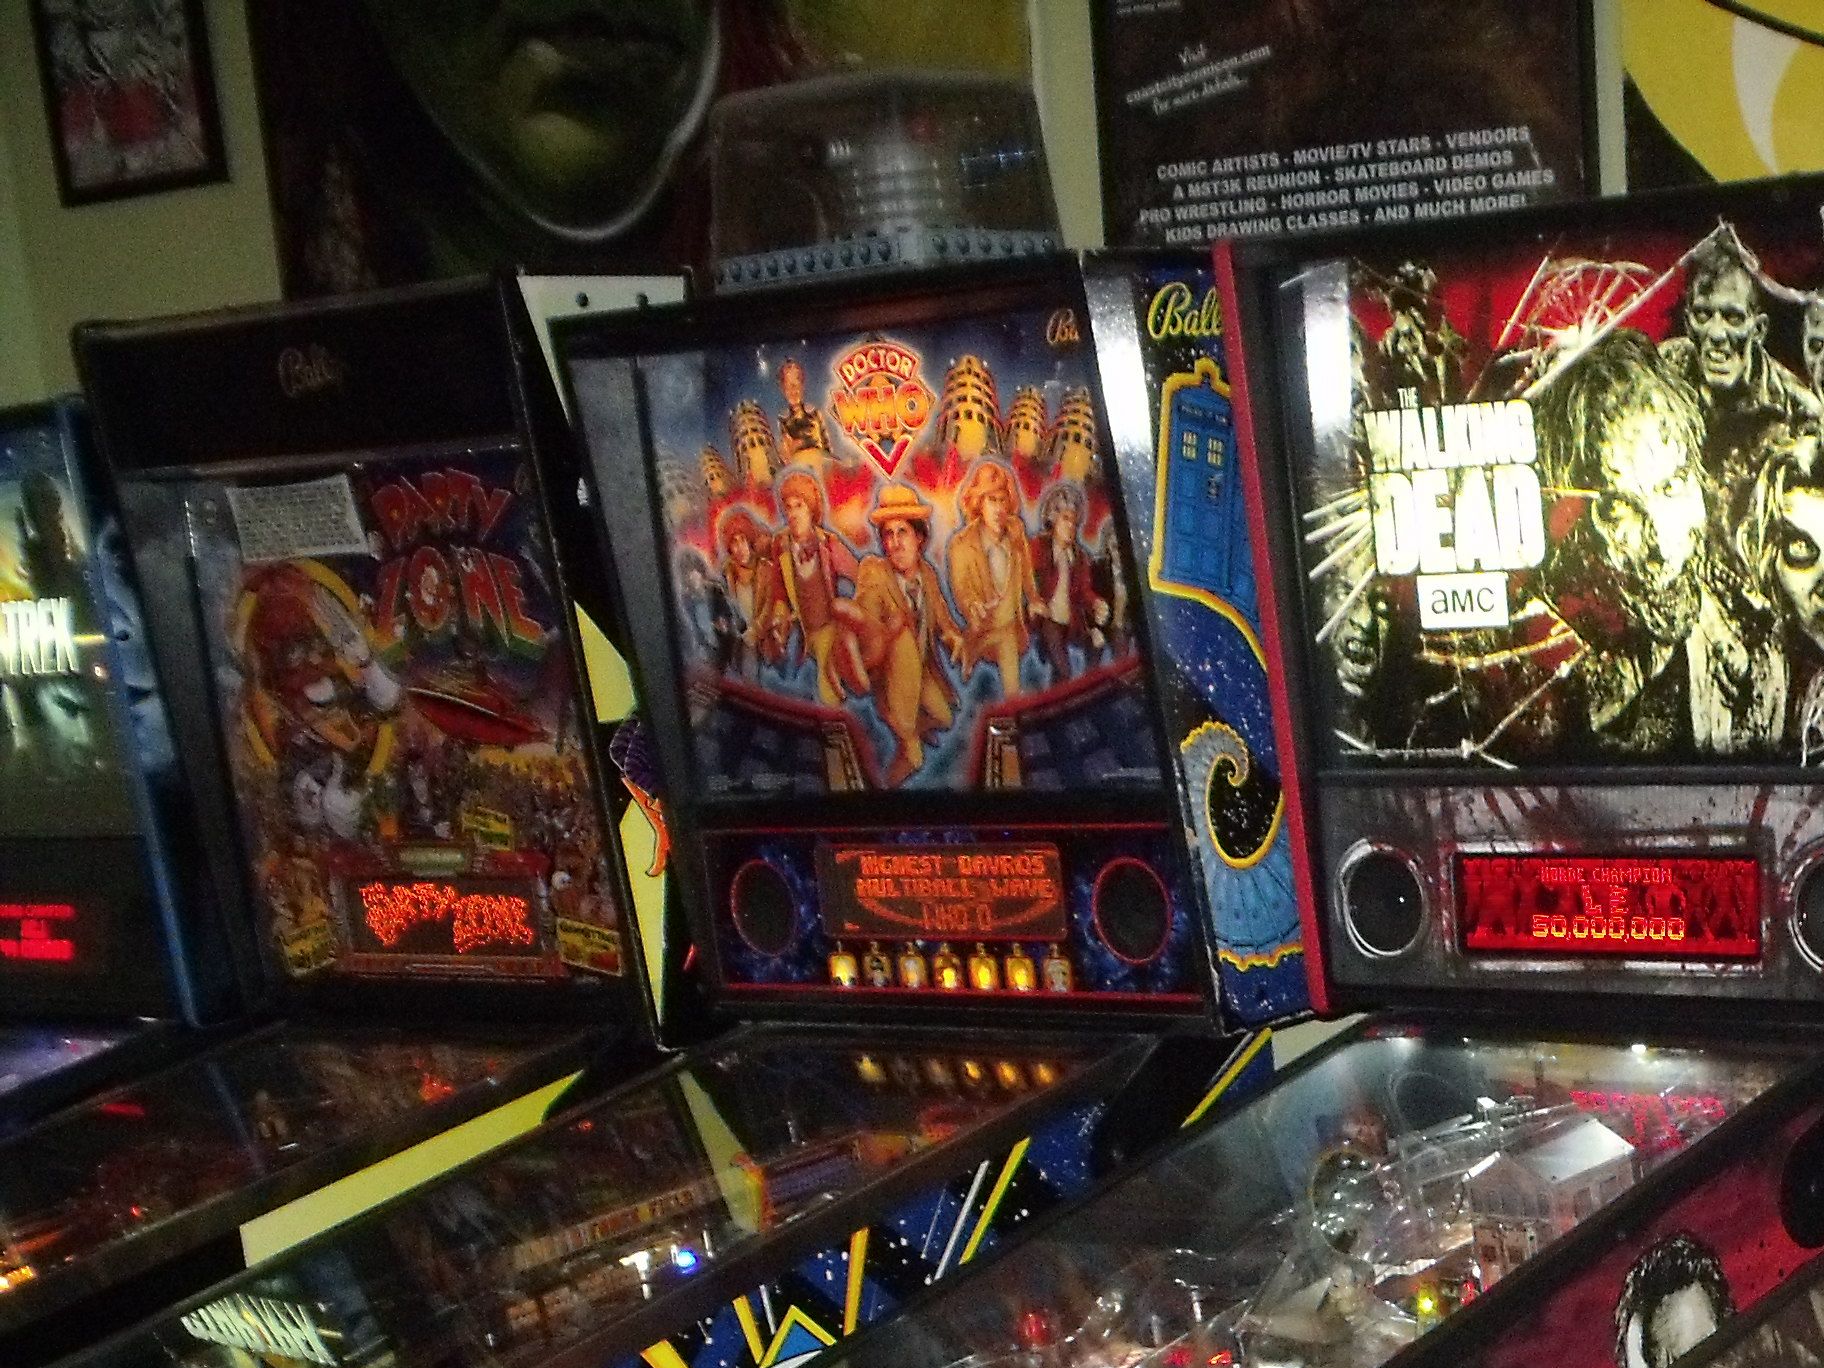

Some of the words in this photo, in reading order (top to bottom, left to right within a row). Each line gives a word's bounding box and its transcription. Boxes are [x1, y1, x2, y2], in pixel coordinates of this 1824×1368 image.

[1157, 161, 1208, 180] COMIC
[1212, 152, 1280, 173] ARTISTS
[1293, 142, 1372, 165] MOVIE/TV
[1376, 135, 1431, 156] STARS
[1446, 125, 1530, 148] VENDORS
[1172, 183, 1185, 200] A
[1246, 169, 1321, 191] REUNION
[1334, 157, 1447, 182] SKATEBOARD
[1453, 149, 1513, 170] DEMOS
[1139, 208, 1171, 224] PRO
[1174, 197, 1267, 221] WRESTLING
[1280, 187, 1350, 210] HORROR
[1355, 181, 1419, 202] MOVIES
[1434, 175, 1487, 195] VIDEO
[1491, 169, 1555, 190] GAMES
[1166, 225, 1202, 242] KIDS
[1206, 217, 1282, 239] DRAWING
[1286, 208, 1360, 231] CLASSES
[1374, 206, 1409, 222] AND
[1414, 198, 1465, 219] MUCH
[1470, 193, 1527, 212] MORE!
[841, 350, 914, 382] DOCTOR
[831, 380, 931, 435] WHO
[1397, 387, 1419, 410] THE
[1363, 399, 1538, 473] WALKING
[371, 468, 514, 550] PARTY
[1369, 463, 1546, 576] DEAD
[363, 546, 548, 652] ZONE
[1, 596, 81, 676] TREK
[856, 877, 975, 898] MULTIBALL
[988, 877, 1054, 898] WAVE
[1540, 866, 1585, 883] HORDE
[1592, 866, 1673, 884] CHAMPION
[1532, 913, 1686, 943] 50,000,000
